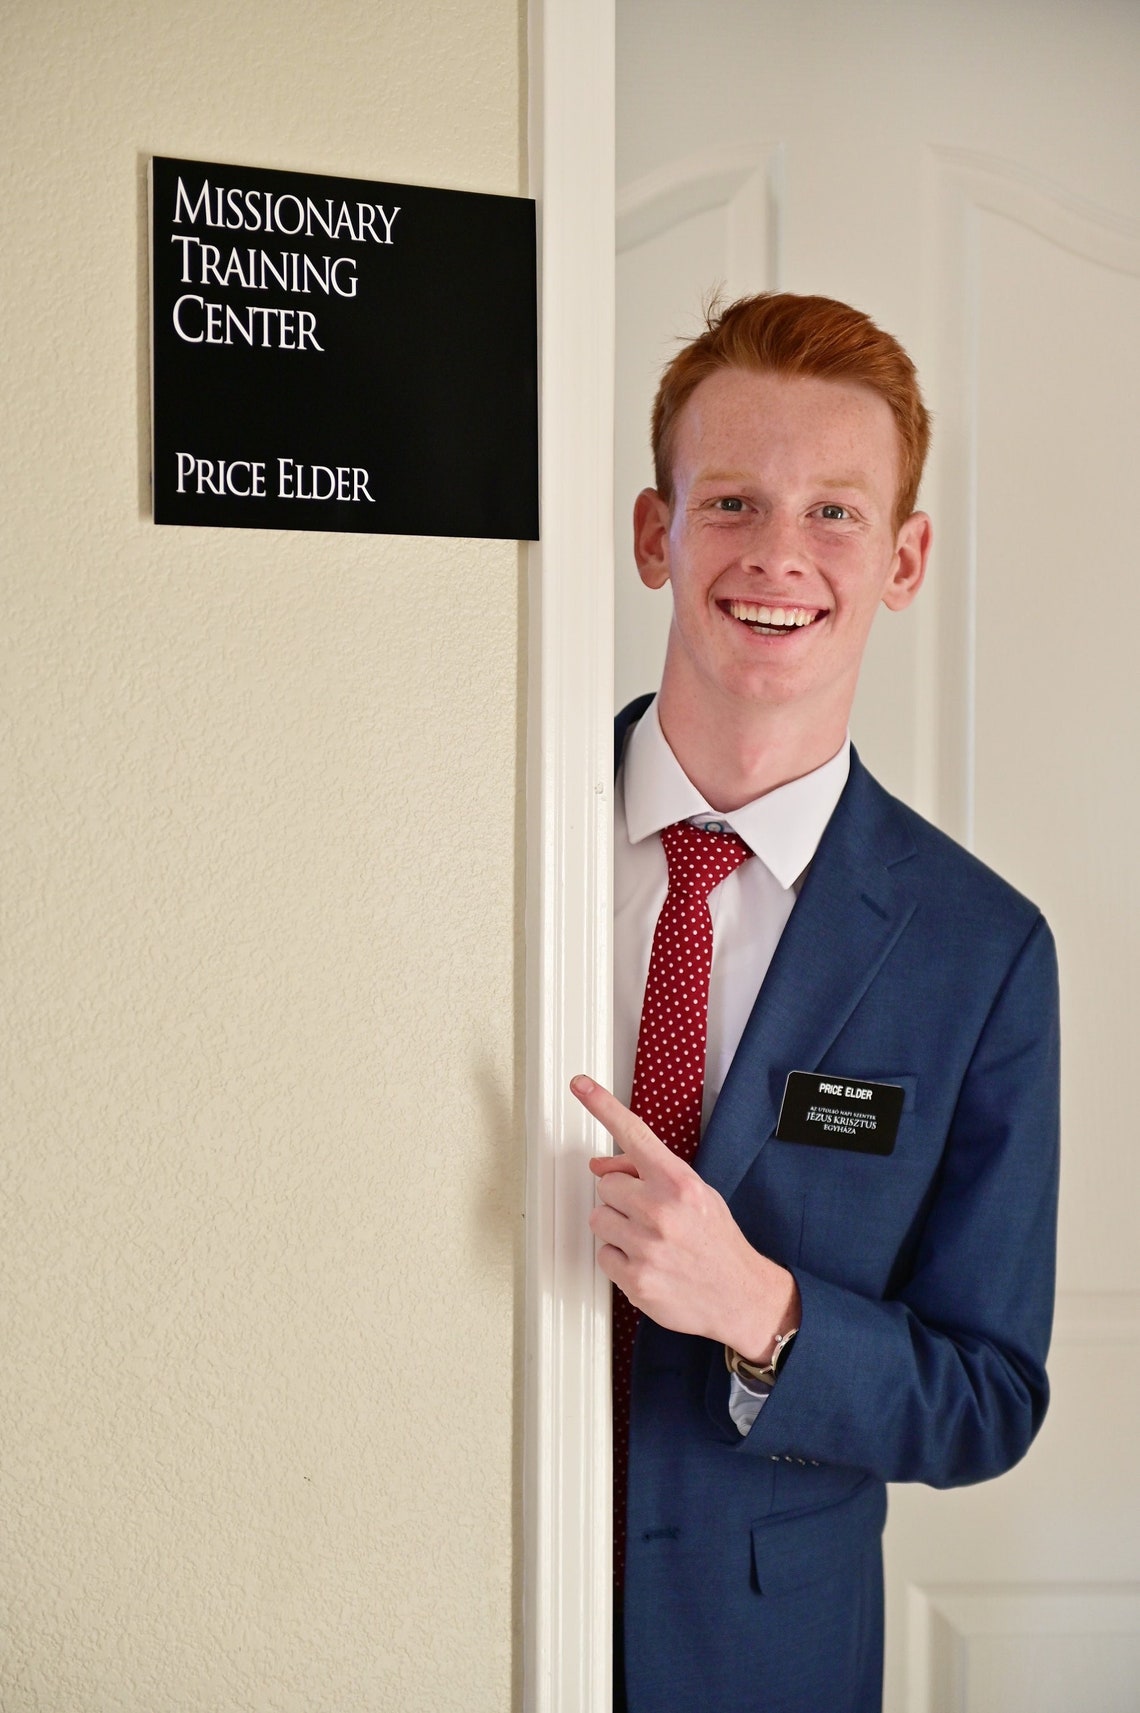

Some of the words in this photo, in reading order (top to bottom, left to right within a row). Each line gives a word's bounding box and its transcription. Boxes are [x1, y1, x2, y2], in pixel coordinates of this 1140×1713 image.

[172, 176, 402, 245] MISSIONARY
[171, 234, 359, 298] TRAINING
[172, 294, 325, 352] CENTER
[175, 452, 267, 497] PRICE
[277, 457, 376, 503] ELDER
[818, 1082, 844, 1097] PRICE
[844, 1086, 873, 1101] ELDER
[806, 1111, 833, 1123] JÉZUS
[833, 1115, 877, 1130] KRISZTUS
[823, 1123, 856, 1135] EGYHÁZA
[853, 1112, 876, 1121] SZENTEK
